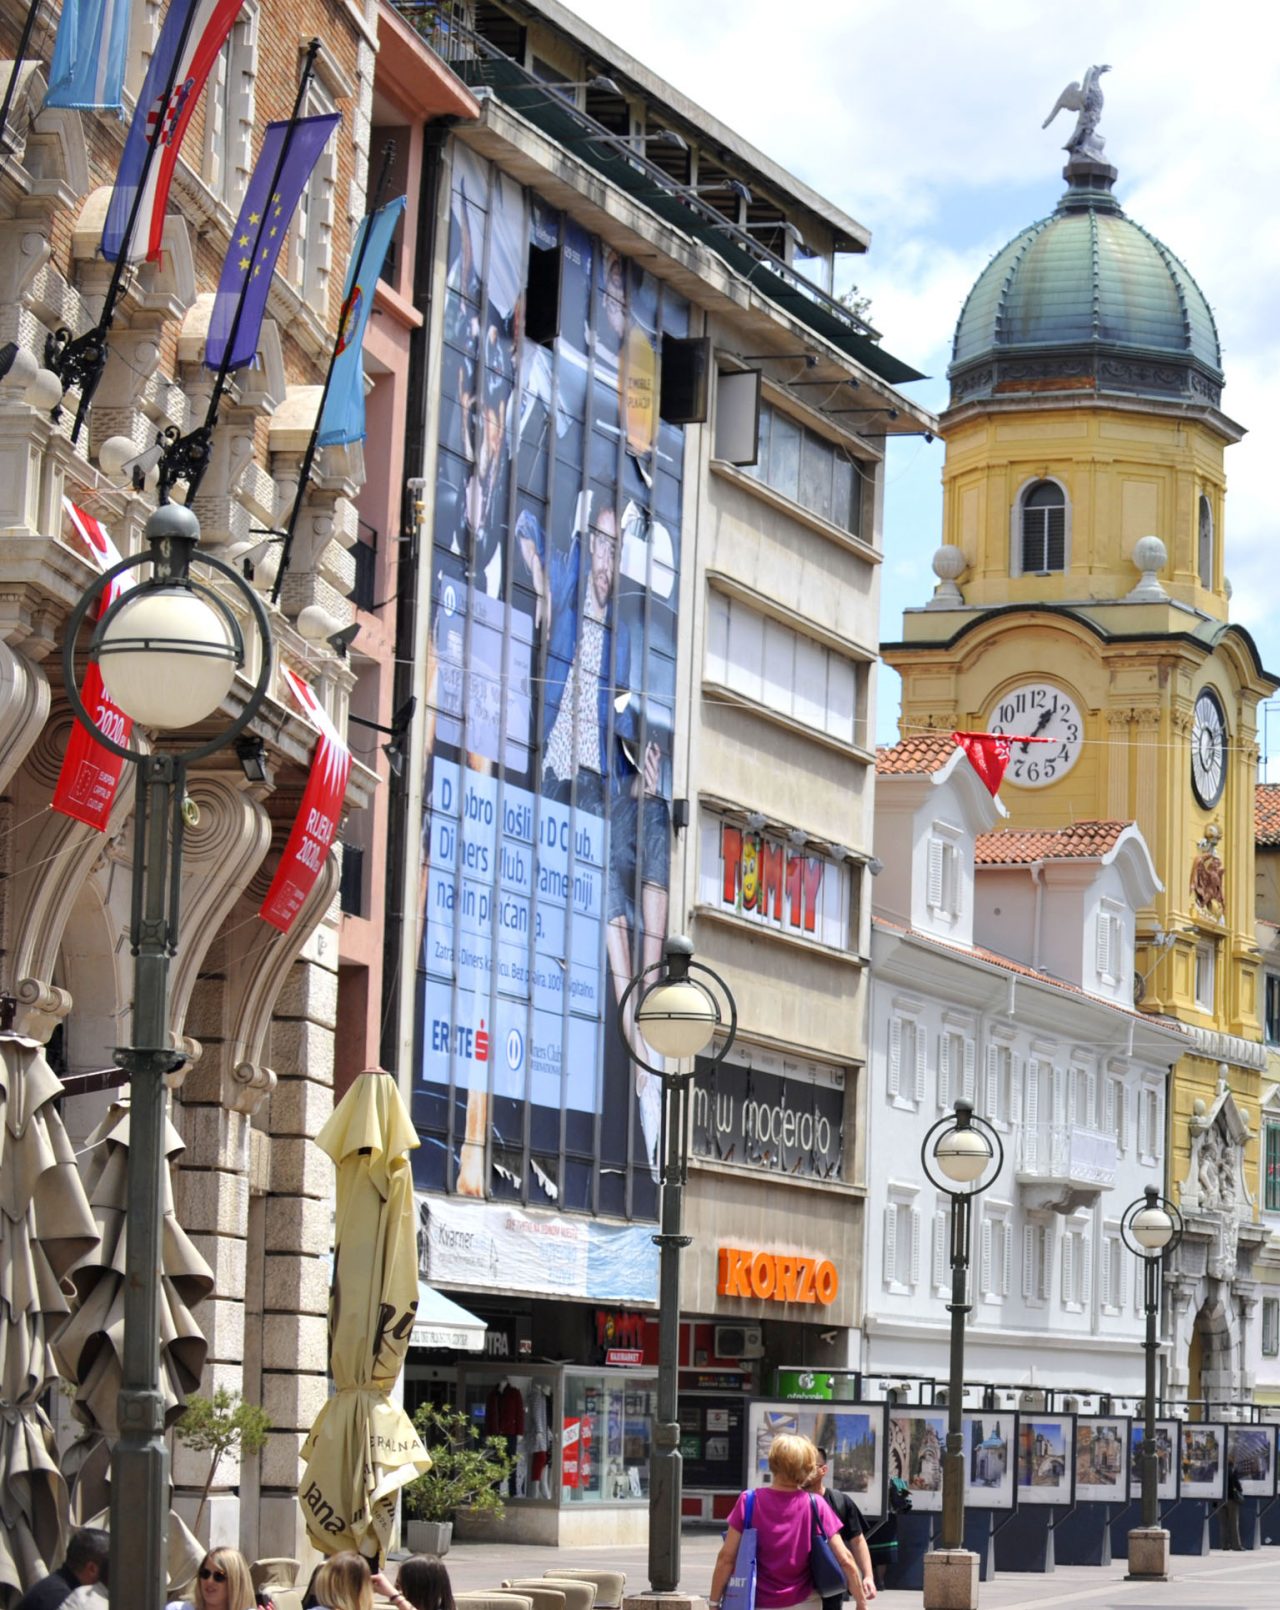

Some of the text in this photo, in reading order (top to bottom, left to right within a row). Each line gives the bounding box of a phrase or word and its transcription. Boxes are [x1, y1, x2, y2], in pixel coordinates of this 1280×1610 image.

[1014, 694, 1026, 713] 11
[1030, 690, 1046, 709] 12
[1052, 694, 1059, 713] 1
[999, 704, 1015, 723] 10
[1060, 704, 1070, 723] 2
[1066, 724, 1078, 743] 3
[1057, 744, 1069, 762] 4
[1013, 760, 1024, 778] 7
[1027, 762, 1040, 782] 6
[1044, 757, 1056, 778] 5
[547, 816, 556, 848] D
[437, 880, 475, 917] nain
[718, 1247, 838, 1305] KORZO
